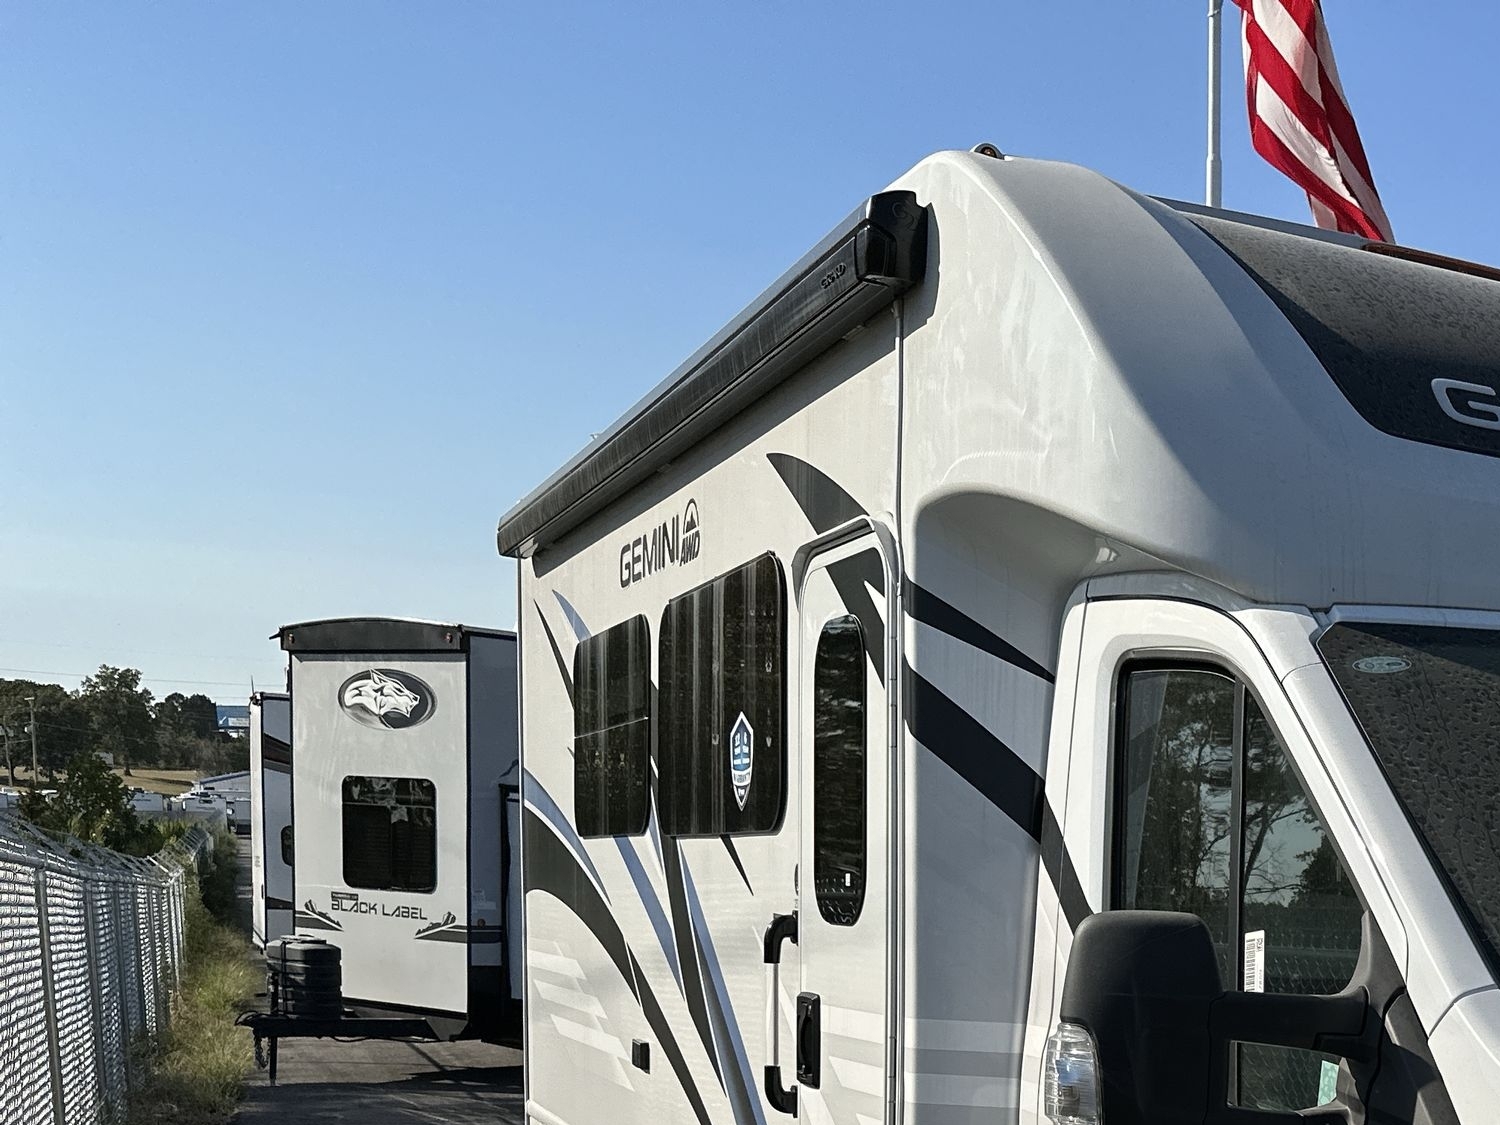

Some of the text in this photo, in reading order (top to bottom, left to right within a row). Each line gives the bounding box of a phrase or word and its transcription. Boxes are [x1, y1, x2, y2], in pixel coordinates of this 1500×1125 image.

[620, 513, 700, 588] GEMINI AWD
[331, 899, 428, 920] BLACK LABEL
